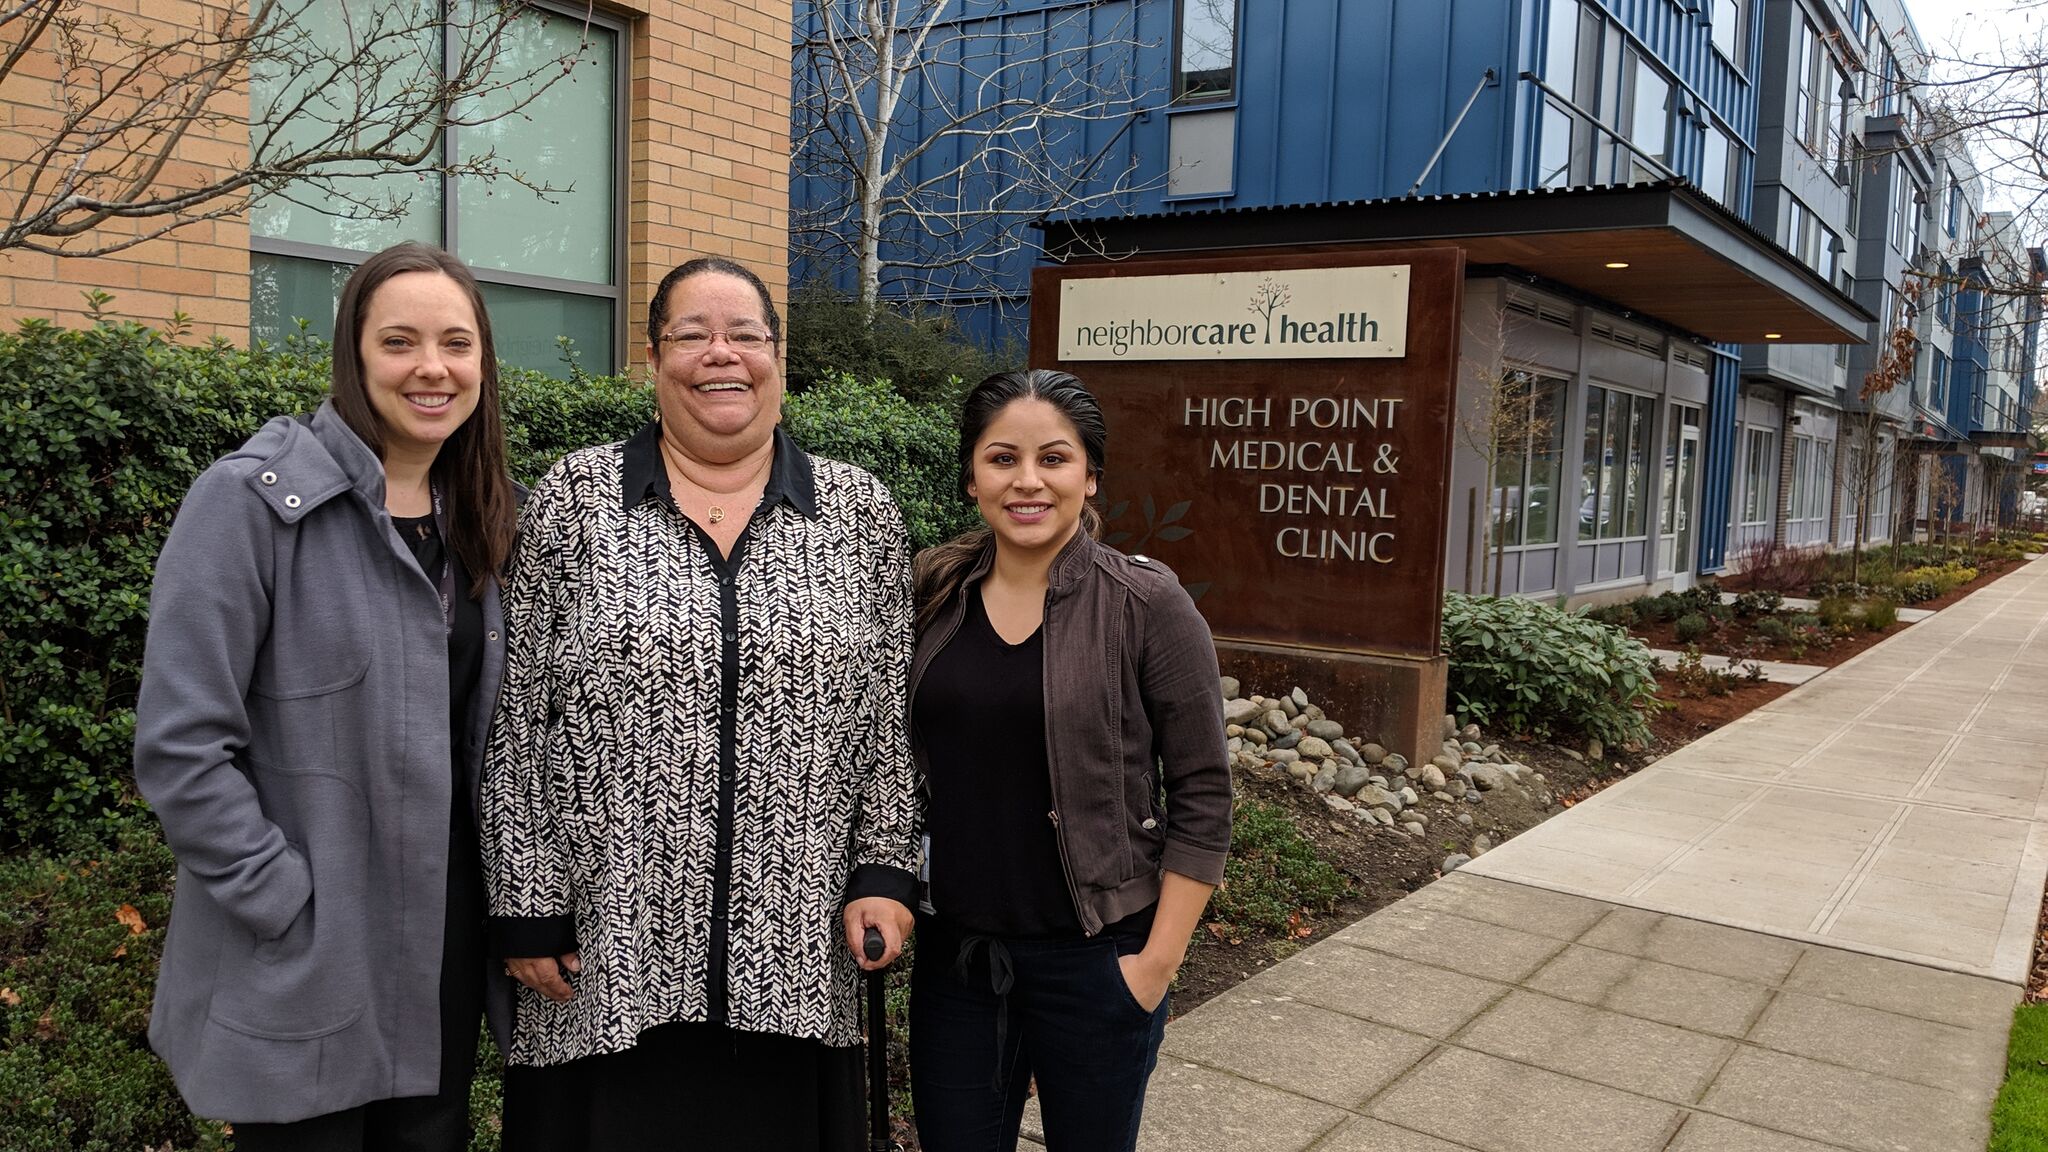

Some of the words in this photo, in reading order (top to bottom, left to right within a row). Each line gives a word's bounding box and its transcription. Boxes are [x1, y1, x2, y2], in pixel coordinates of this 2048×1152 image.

[1076, 314, 1256, 356] neighborcare
[1280, 312, 1379, 344] health
[1184, 398, 1272, 427] HIGH
[1289, 398, 1403, 429] POINT
[1209, 440, 1363, 474] MEDICAL
[1373, 443, 1399, 474] &
[1259, 484, 1397, 519] DENTAL
[1276, 527, 1395, 564] CLINIC
